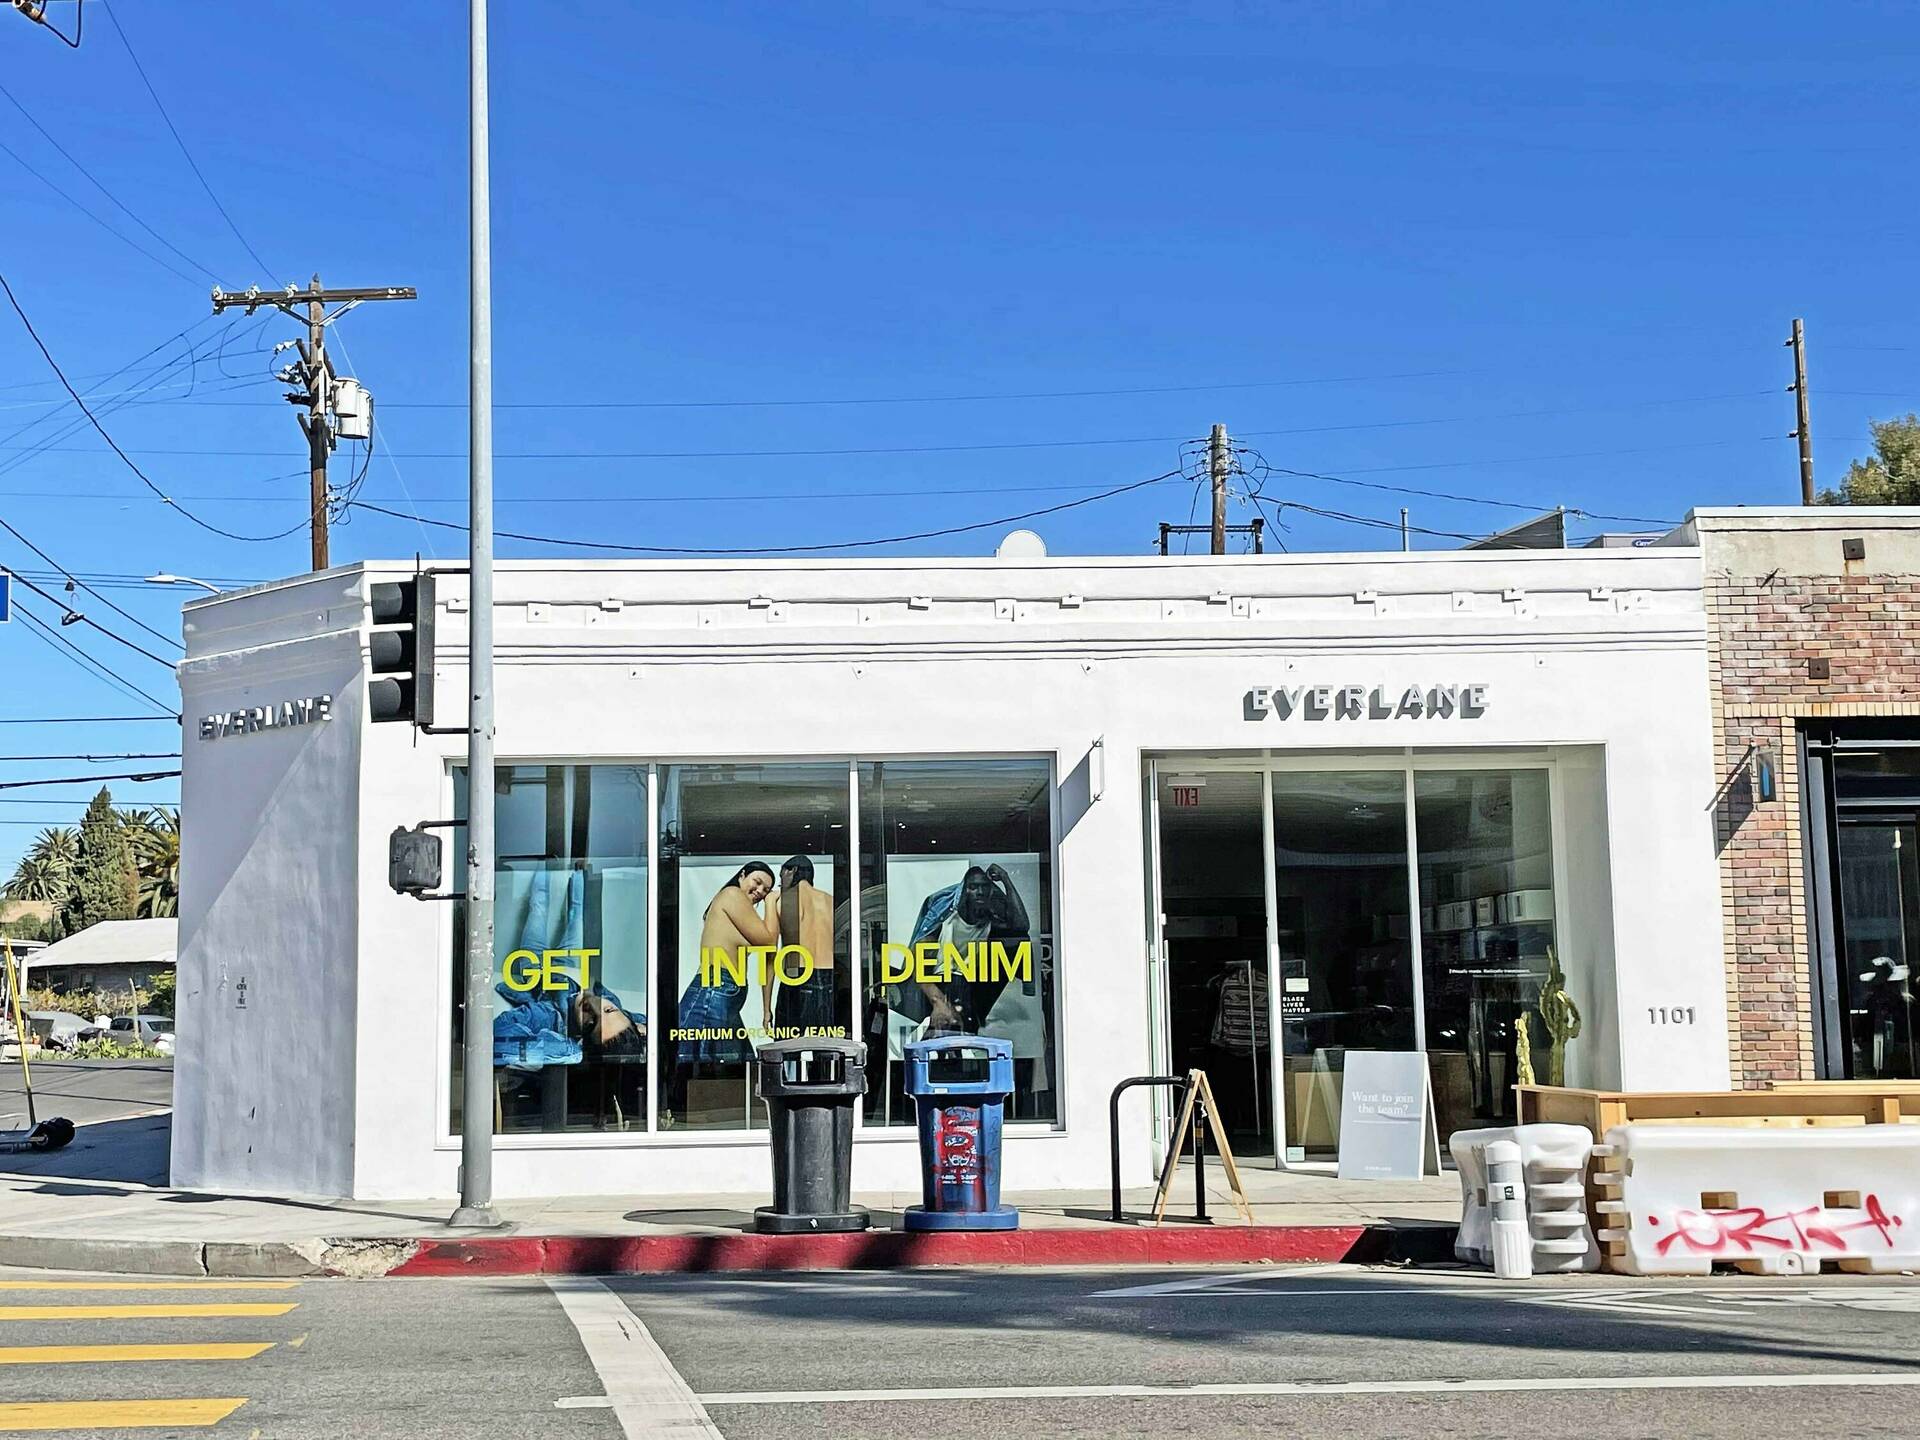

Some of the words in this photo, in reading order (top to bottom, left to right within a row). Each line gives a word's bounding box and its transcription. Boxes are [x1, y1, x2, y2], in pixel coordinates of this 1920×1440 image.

[1243, 684, 1490, 721] EVERLANE
[198, 694, 333, 740] EVERLANE
[502, 949, 600, 992] GET
[701, 944, 814, 988] INTO
[881, 941, 1032, 984] DENIM
[1648, 1006, 1696, 1024] 1101
[669, 1028, 732, 1041] PREMIUM
[736, 1026, 800, 1040] ORGANIC
[804, 1025, 846, 1038] JEANS
[1352, 1091, 1378, 1102] Want
[1382, 1092, 1392, 1102] to
[1394, 1092, 1414, 1105] join
[1358, 1103, 1374, 1113] the
[1377, 1103, 1408, 1115] team?
